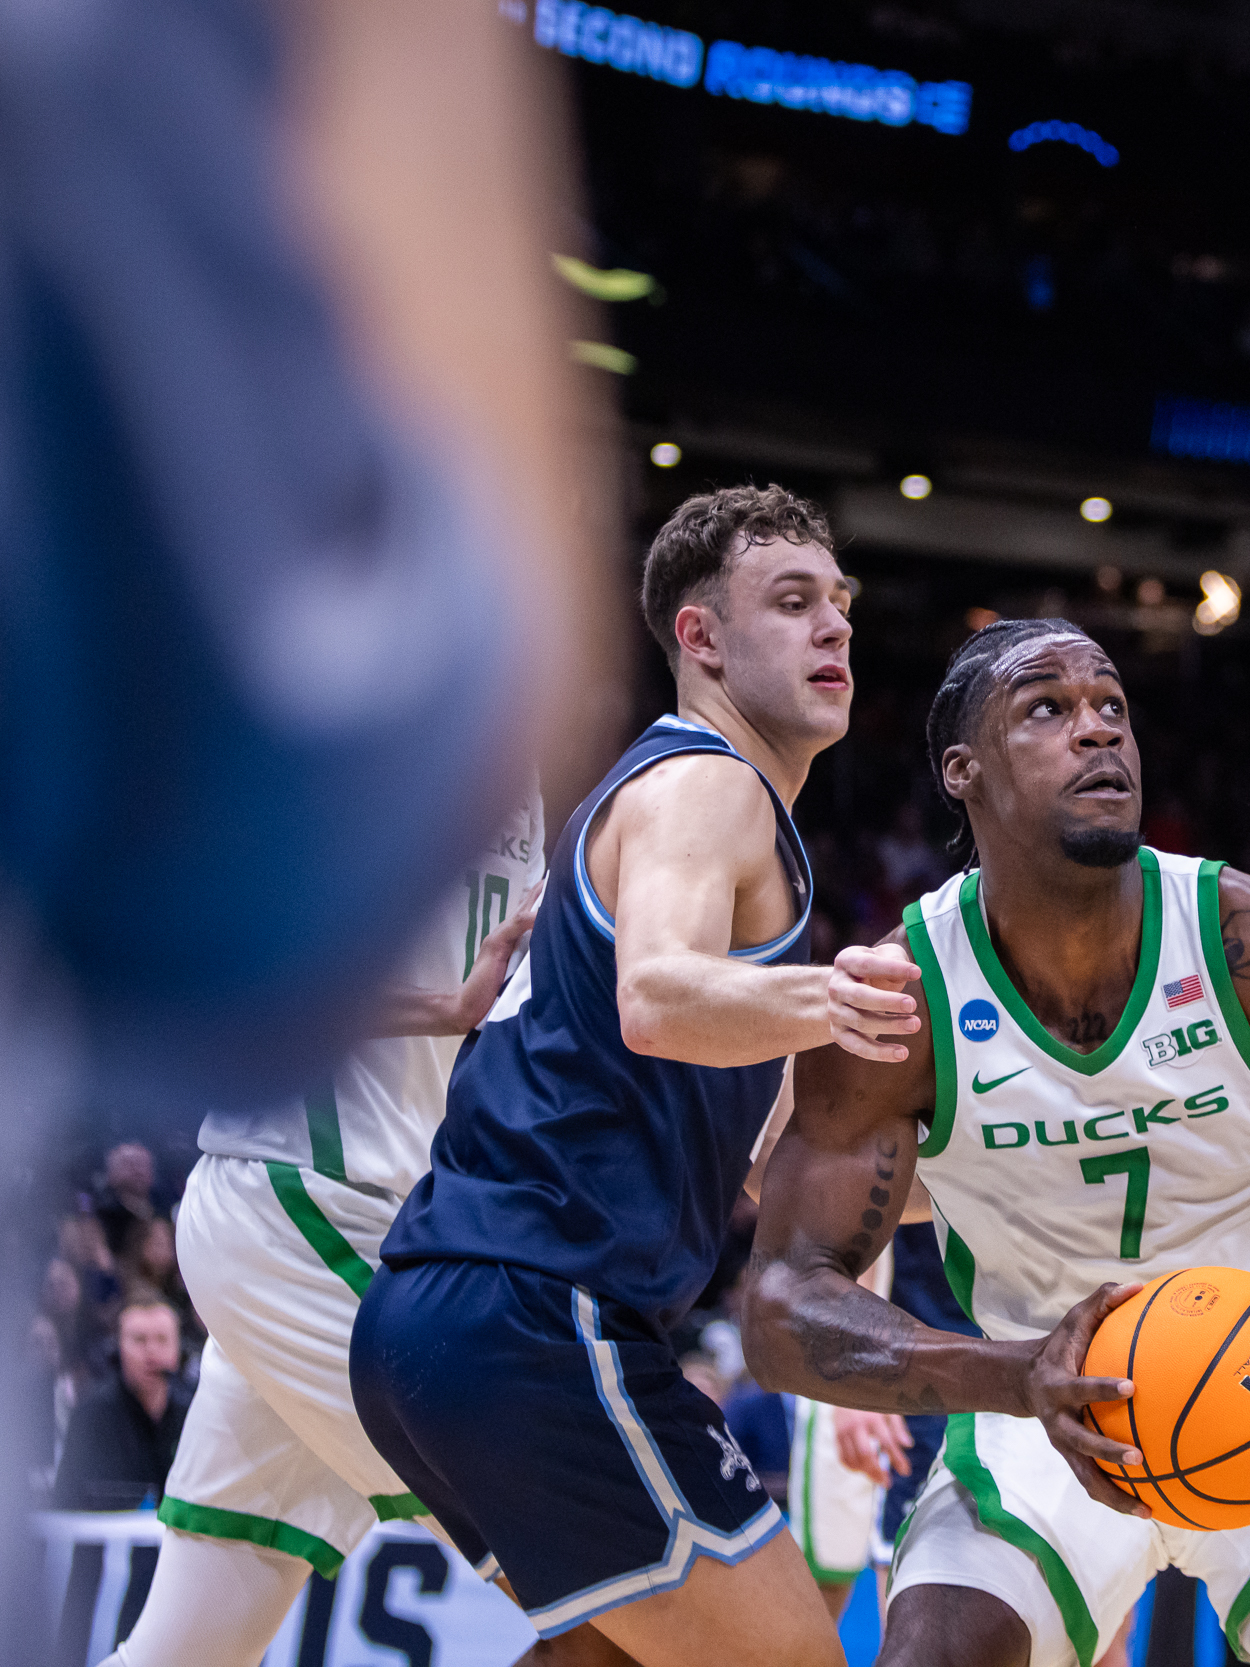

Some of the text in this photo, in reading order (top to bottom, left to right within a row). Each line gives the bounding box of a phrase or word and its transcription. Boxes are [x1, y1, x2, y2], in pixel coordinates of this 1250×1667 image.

[964, 1019, 997, 1032] NCAA
[981, 1085, 1229, 1149] DUCKS
[1079, 1146, 1151, 1259] 7
